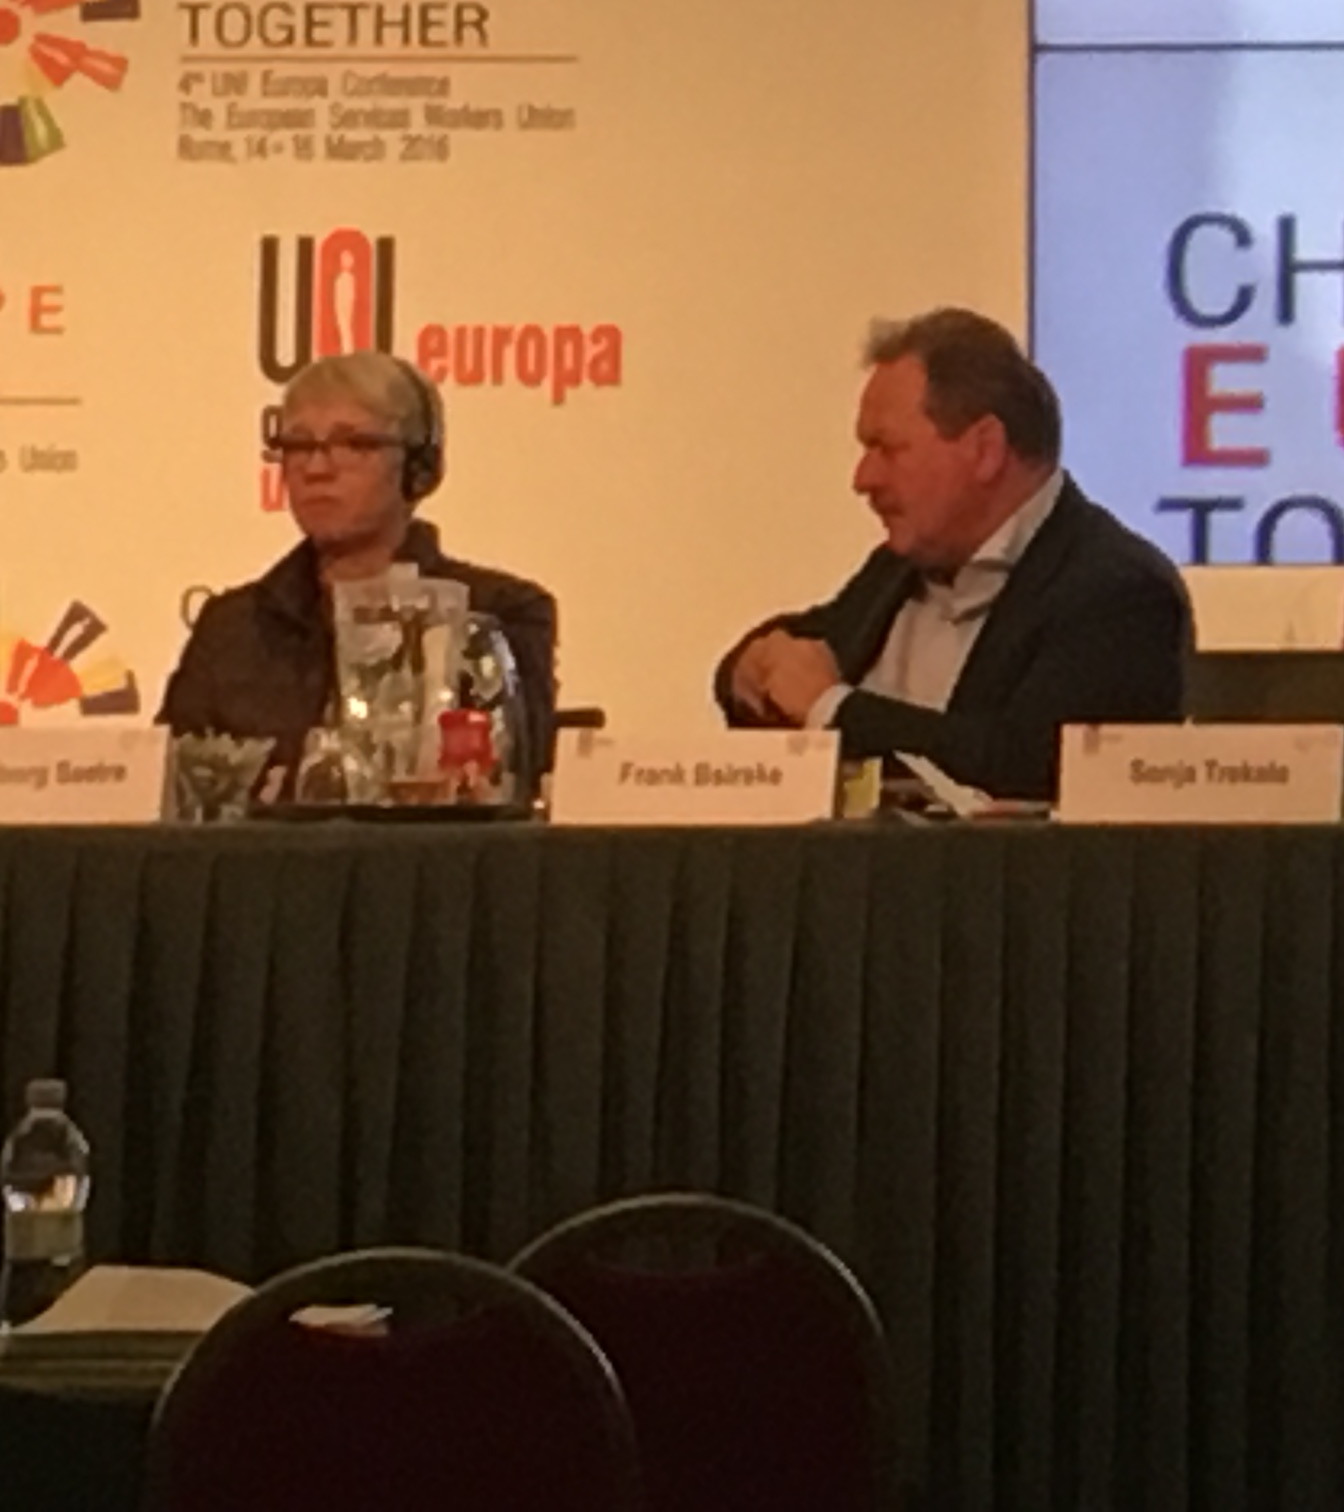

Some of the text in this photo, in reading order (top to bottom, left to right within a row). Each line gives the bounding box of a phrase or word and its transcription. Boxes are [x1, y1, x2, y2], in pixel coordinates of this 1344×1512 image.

[179, 1, 489, 49] TOGETHER
[416, 321, 623, 406] europa
[618, 761, 687, 786] Frank
